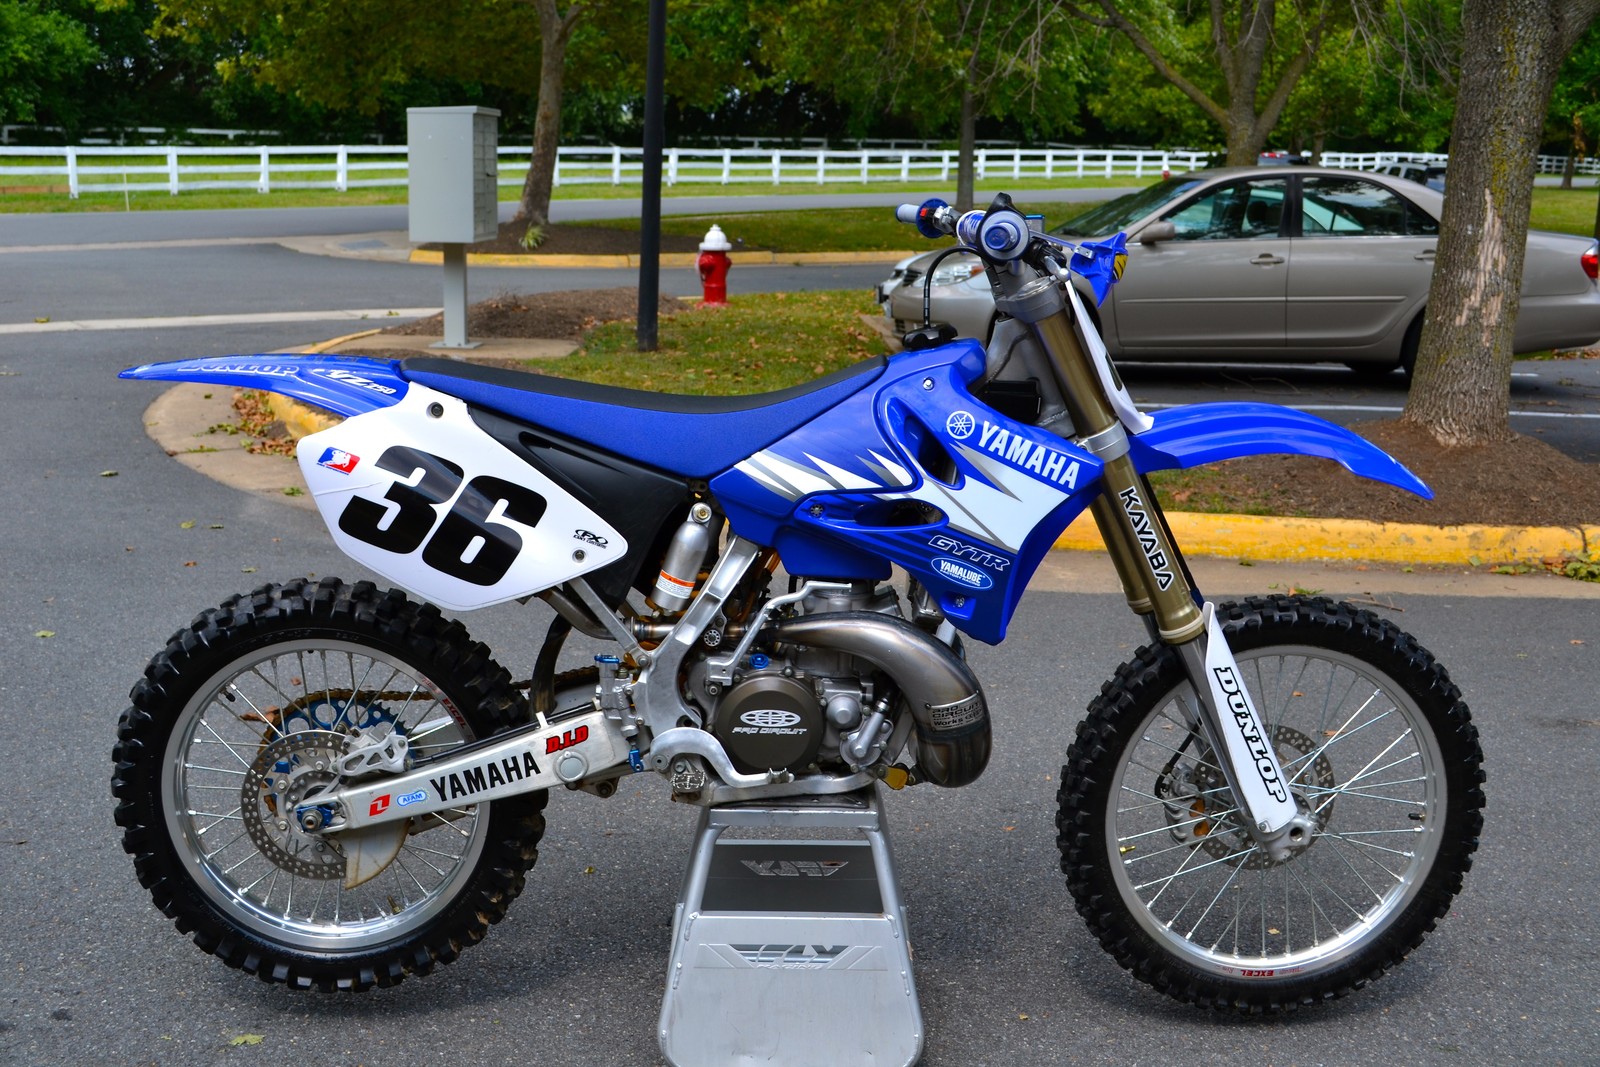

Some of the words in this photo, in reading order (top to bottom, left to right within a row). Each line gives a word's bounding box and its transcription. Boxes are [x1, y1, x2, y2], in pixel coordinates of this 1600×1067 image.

[978, 420, 1080, 490] YAMAHA
[338, 445, 548, 587] 36
[928, 534, 1011, 572] GYTR
[1119, 486, 1174, 591] KAYABA
[940, 560, 983, 584] YAMALUBE
[442, 698, 466, 729] EXCEL
[732, 726, 759, 735] PRO
[759, 727, 808, 736] CIRCUIT
[933, 718, 964, 727] Works
[1213, 666, 1287, 803] DUNLOP
[430, 751, 541, 802] YAMAHA
[1240, 968, 1275, 978] EXCEL
